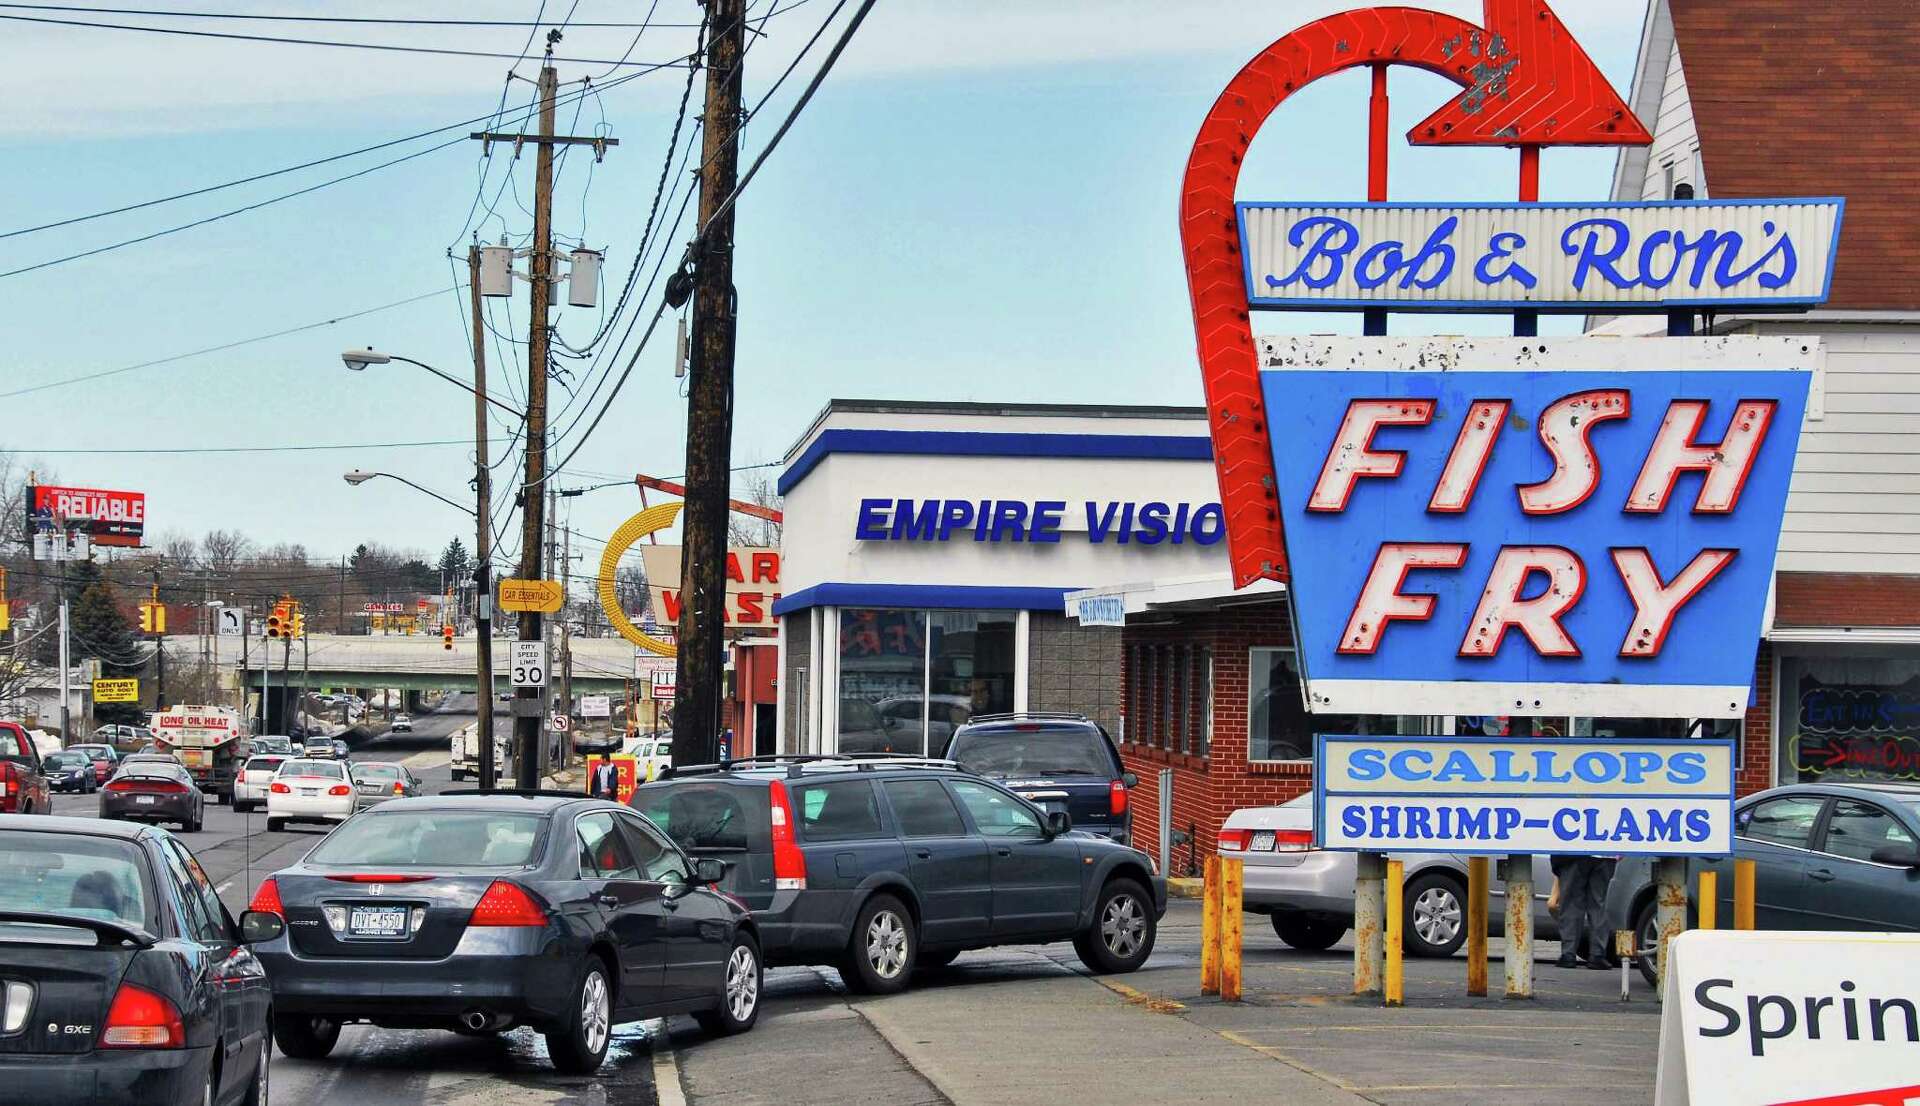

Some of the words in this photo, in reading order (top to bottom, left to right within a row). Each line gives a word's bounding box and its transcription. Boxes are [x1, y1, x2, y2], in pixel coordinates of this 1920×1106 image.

[1267, 215, 1458, 290] Bob
[1474, 232, 1537, 290] &
[1560, 216, 1798, 291] Ron's
[1304, 388, 1779, 515] FISH
[57, 495, 143, 522] RELIABLE
[855, 498, 1066, 543] EMPIRE
[1085, 502, 1227, 546] VISIO
[726, 552, 779, 583] AR
[504, 590, 516, 600] CAR
[518, 590, 550, 601] ESSENTIALS
[1334, 541, 1741, 658] FRY
[513, 667, 543, 683] 30
[160, 716, 184, 728] LONG
[188, 717, 202, 725] OIL
[204, 718, 229, 726] HEAT
[1347, 748, 1707, 784] SCALLOPS
[1342, 804, 1711, 842] SHRIMP-CLAMS
[64, 1025, 91, 1034] GXE
[1694, 978, 1920, 1057] Sprin
